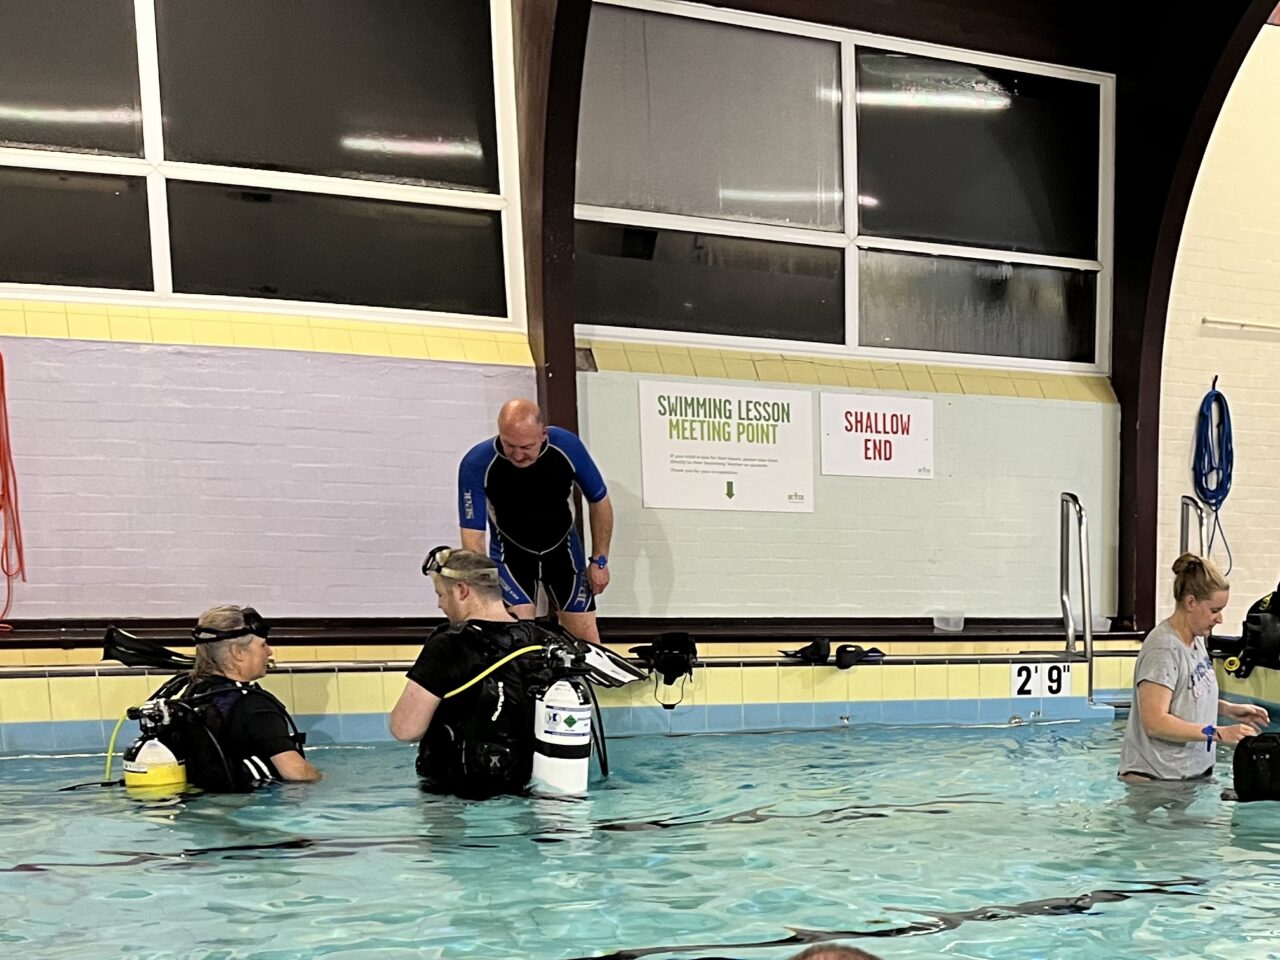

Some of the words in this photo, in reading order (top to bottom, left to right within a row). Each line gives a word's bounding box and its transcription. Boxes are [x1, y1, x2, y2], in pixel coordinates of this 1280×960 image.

[657, 394, 732, 420] SWIMMING
[737, 399, 791, 423] LESSON
[668, 418, 731, 443] MEETING
[736, 421, 779, 445] POINT
[844, 410, 911, 436] SHALLOW
[863, 438, 893, 461] END
